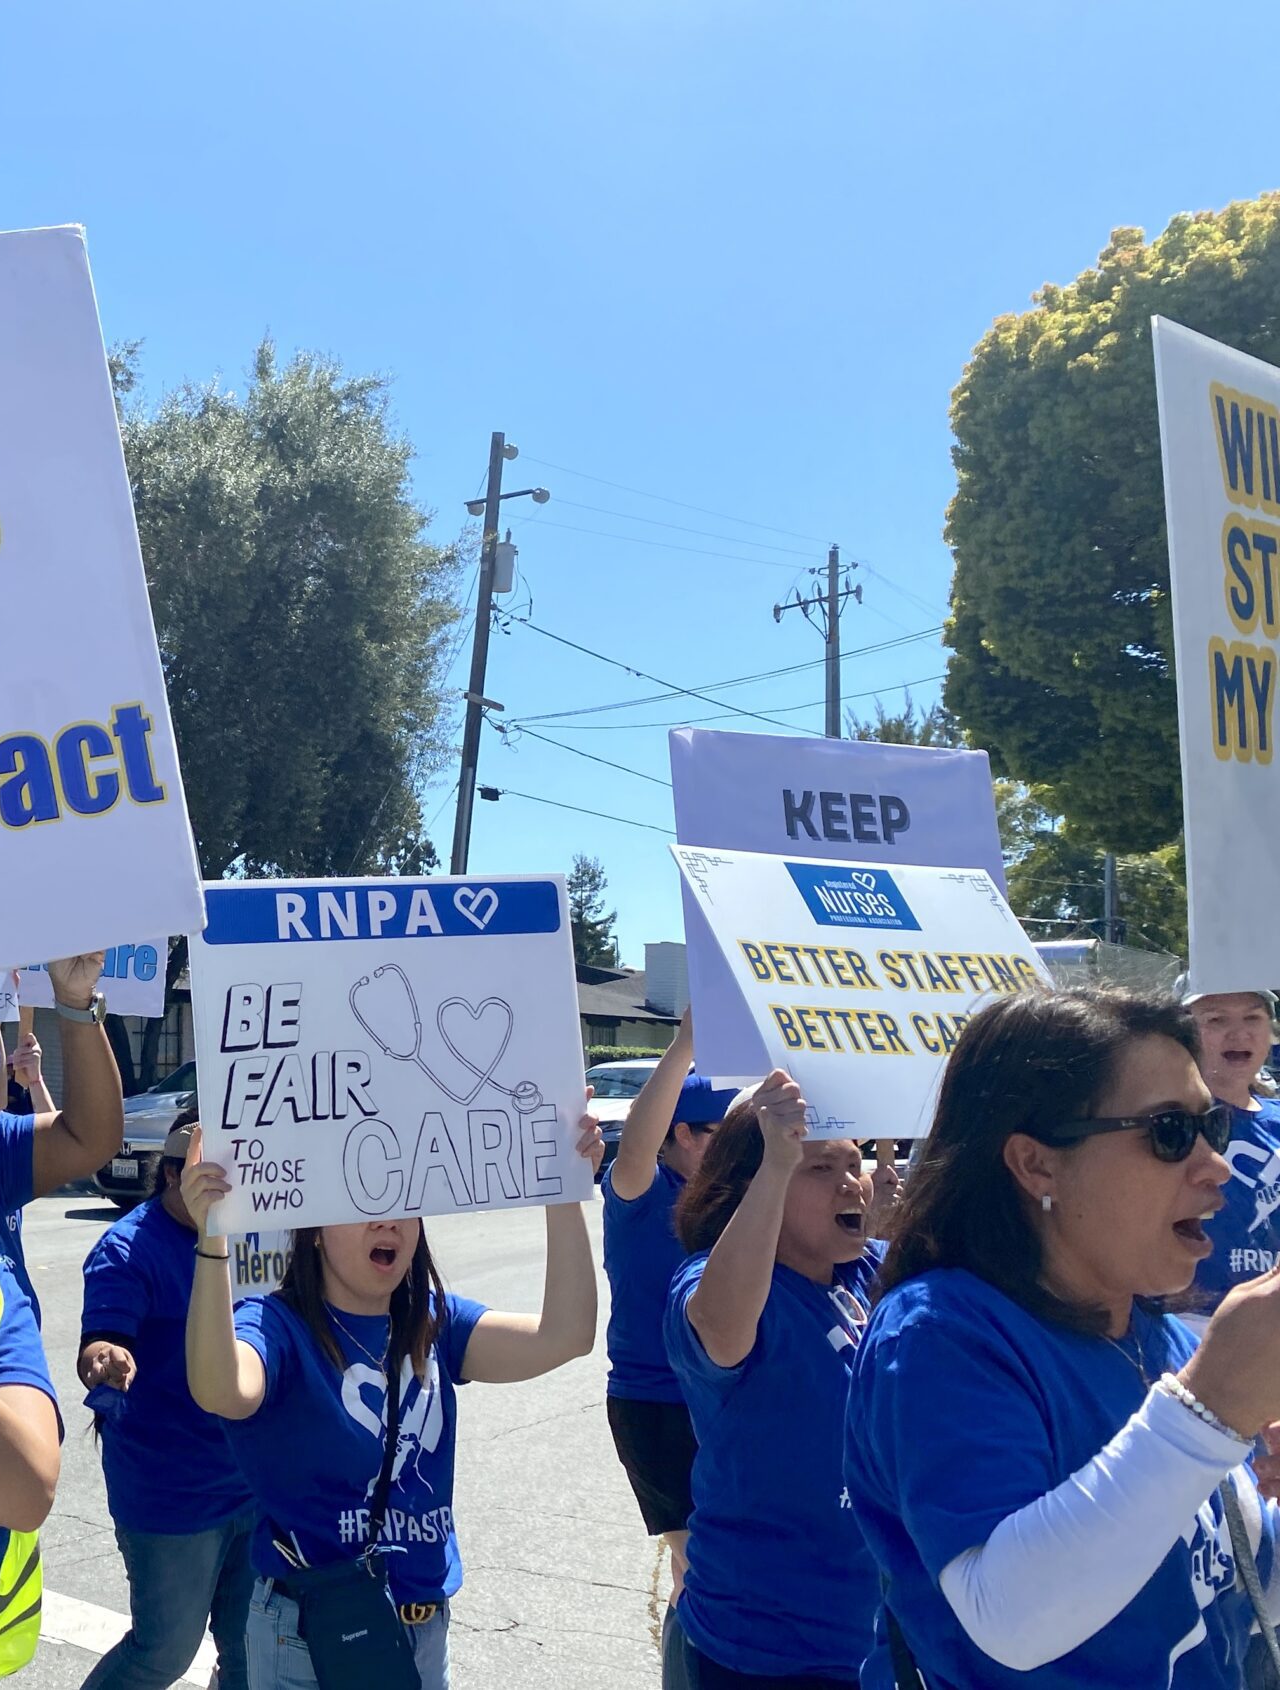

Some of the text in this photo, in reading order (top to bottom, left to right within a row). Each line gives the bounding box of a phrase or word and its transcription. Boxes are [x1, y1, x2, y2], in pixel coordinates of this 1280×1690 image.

[1212, 645, 1273, 757] MY
[782, 789, 911, 845] KEEP
[276, 889, 443, 939] RNPA
[814, 885, 896, 917] Nurses
[738, 939, 1037, 993] BETTER STAFFING
[220, 982, 303, 1053] BE
[769, 1004, 916, 1057] BETTER
[221, 1050, 379, 1130] FAIR
[231, 1139, 264, 1161] TO
[238, 1159, 306, 1185] THOSE
[343, 1104, 562, 1215] CARE
[252, 1190, 303, 1212] WHO
